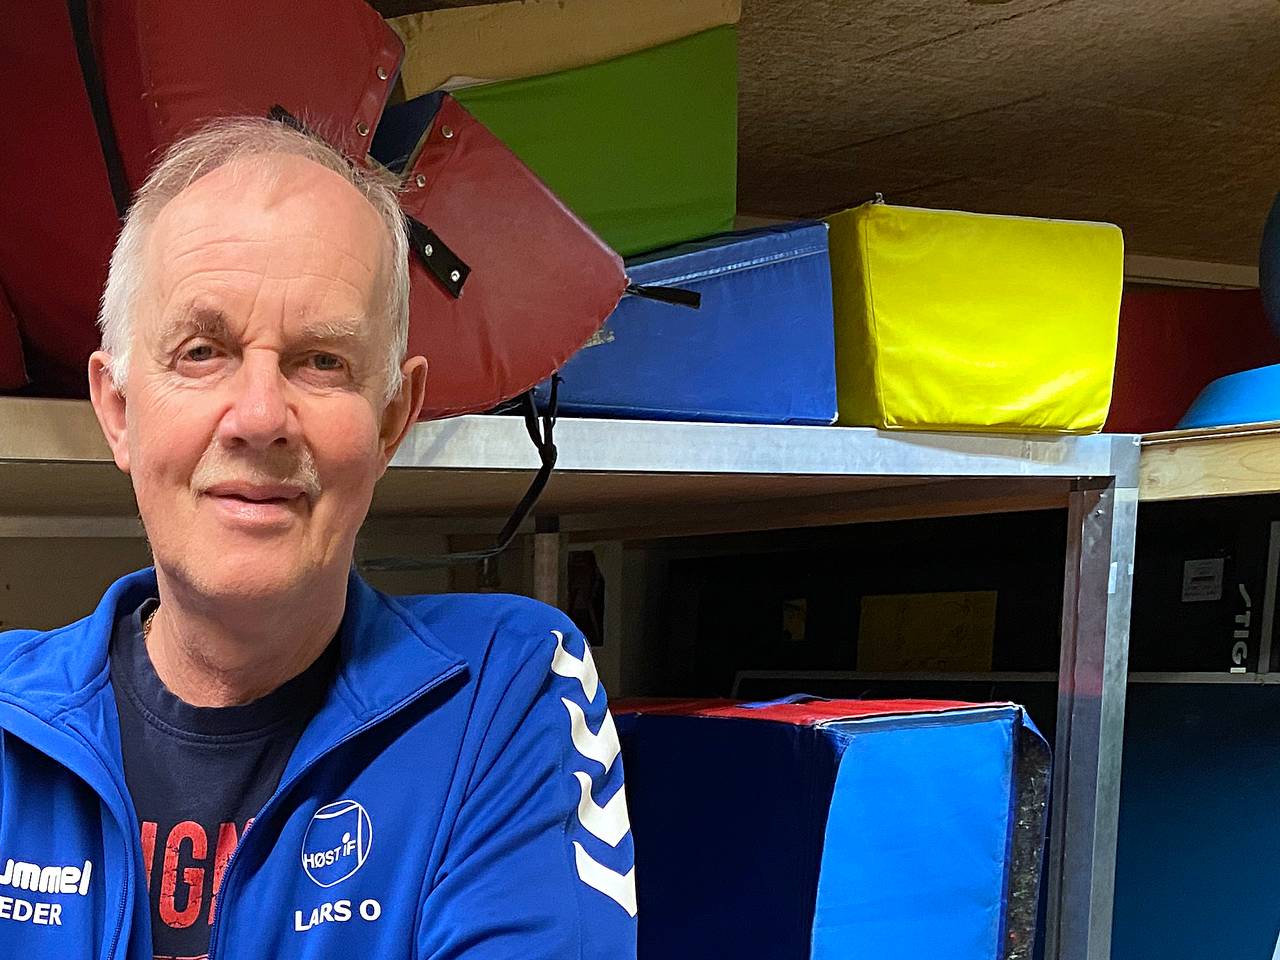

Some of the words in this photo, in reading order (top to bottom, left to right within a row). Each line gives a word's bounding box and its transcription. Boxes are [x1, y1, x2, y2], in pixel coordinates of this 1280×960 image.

[303, 846, 342, 869] HØST
[295, 900, 352, 932] LARS
[360, 899, 381, 921] O
